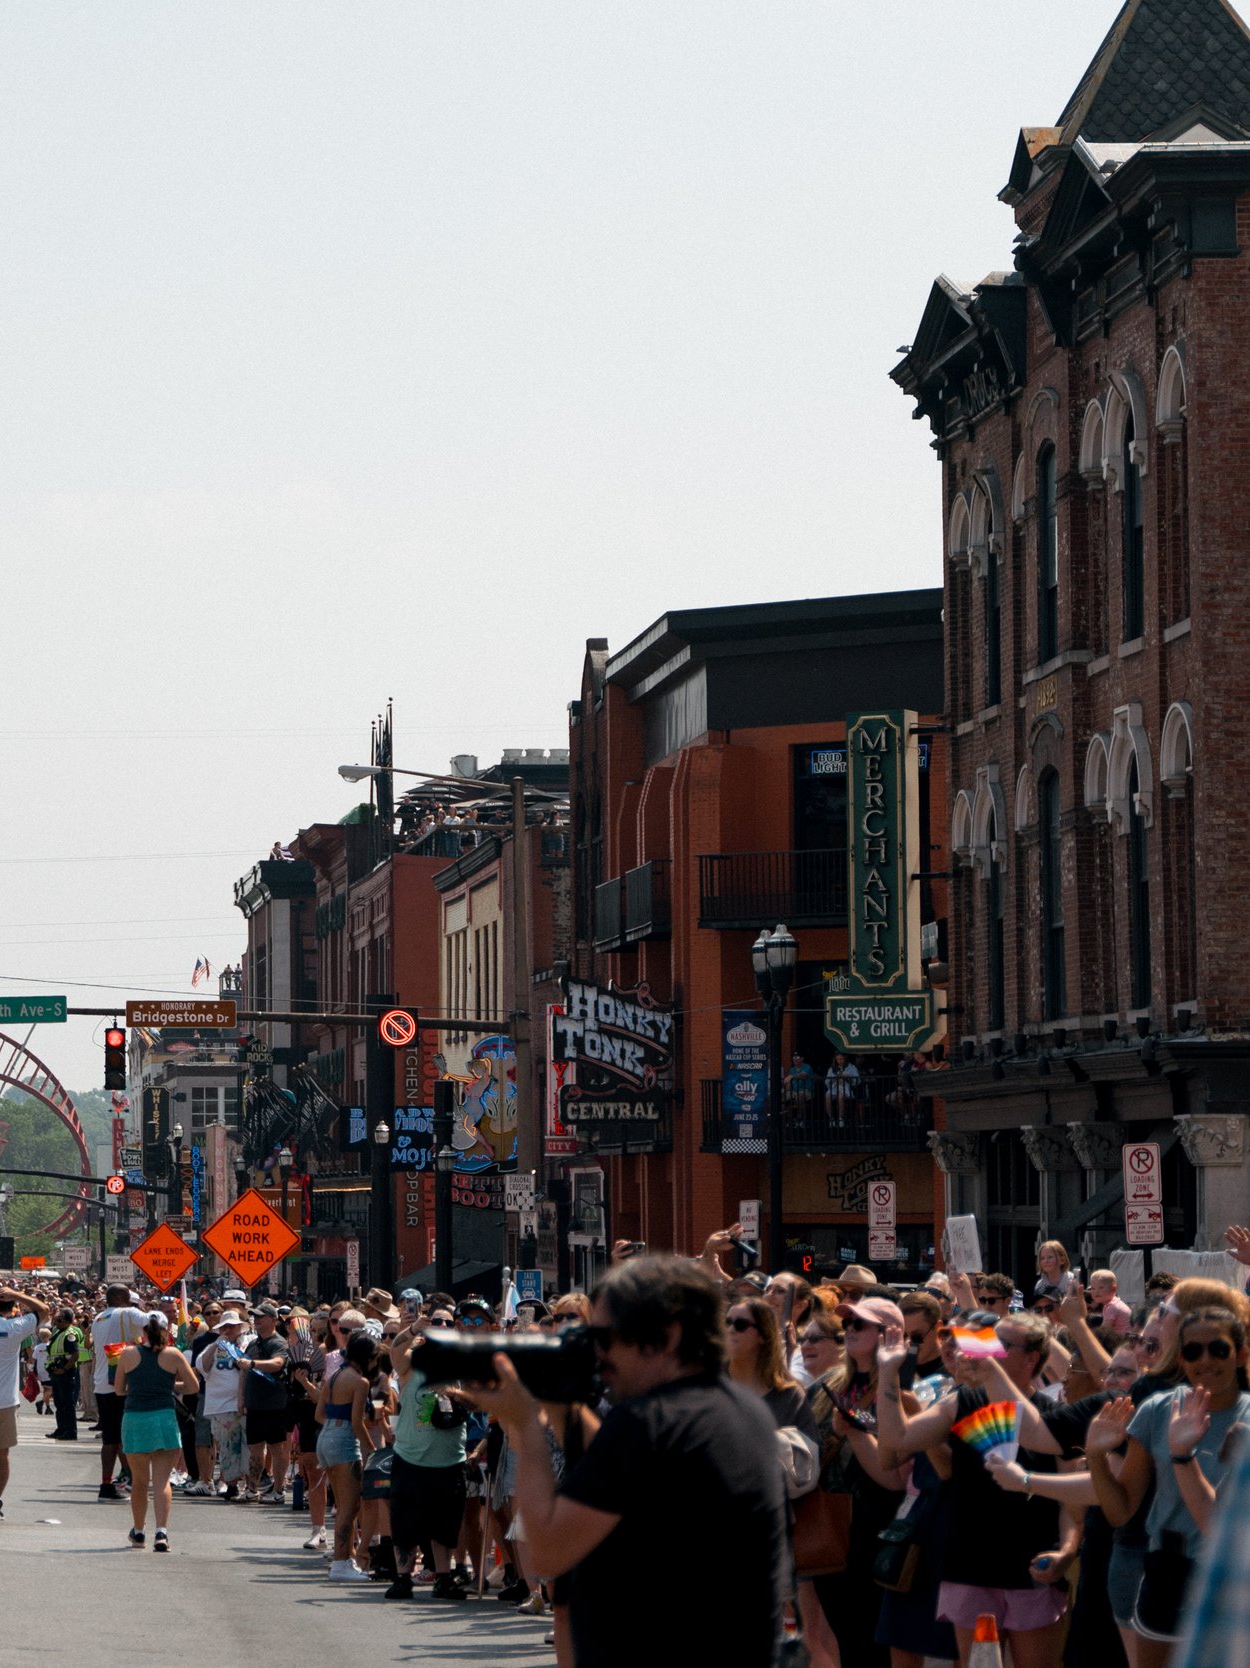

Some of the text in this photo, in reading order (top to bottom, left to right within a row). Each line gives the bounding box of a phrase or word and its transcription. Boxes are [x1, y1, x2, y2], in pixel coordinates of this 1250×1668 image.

[817, 752, 843, 763] BUD
[813, 762, 848, 774] LIGHT
[859, 726, 889, 977] MERCHANTS
[160, 1002, 196, 1011] HONORARY
[567, 980, 672, 1045] HONKY
[131, 1011, 230, 1026] Bridgestone Dr
[836, 1005, 922, 1022] RESTAURANT
[849, 1021, 909, 1038] & GRILL
[730, 1032, 763, 1041] NASHVILLE
[555, 1017, 645, 1082] TONK
[405, 1046, 419, 1099] TCHEN
[734, 1080, 758, 1094] ally
[566, 1101, 659, 1121] CENTRAL
[1130, 1175, 1155, 1183] LOADING
[1135, 1184, 1151, 1192] ZONE
[507, 1193, 519, 1206] OK
[406, 1193, 419, 1227] BAR
[233, 1214, 271, 1227] ROAD
[232, 1232, 270, 1245] WORK
[144, 1247, 185, 1256] LANE ENDS
[227, 1250, 274, 1263] AHEAD
[152, 1258, 176, 1268] MERGE
[155, 1270, 172, 1278] LEFT
